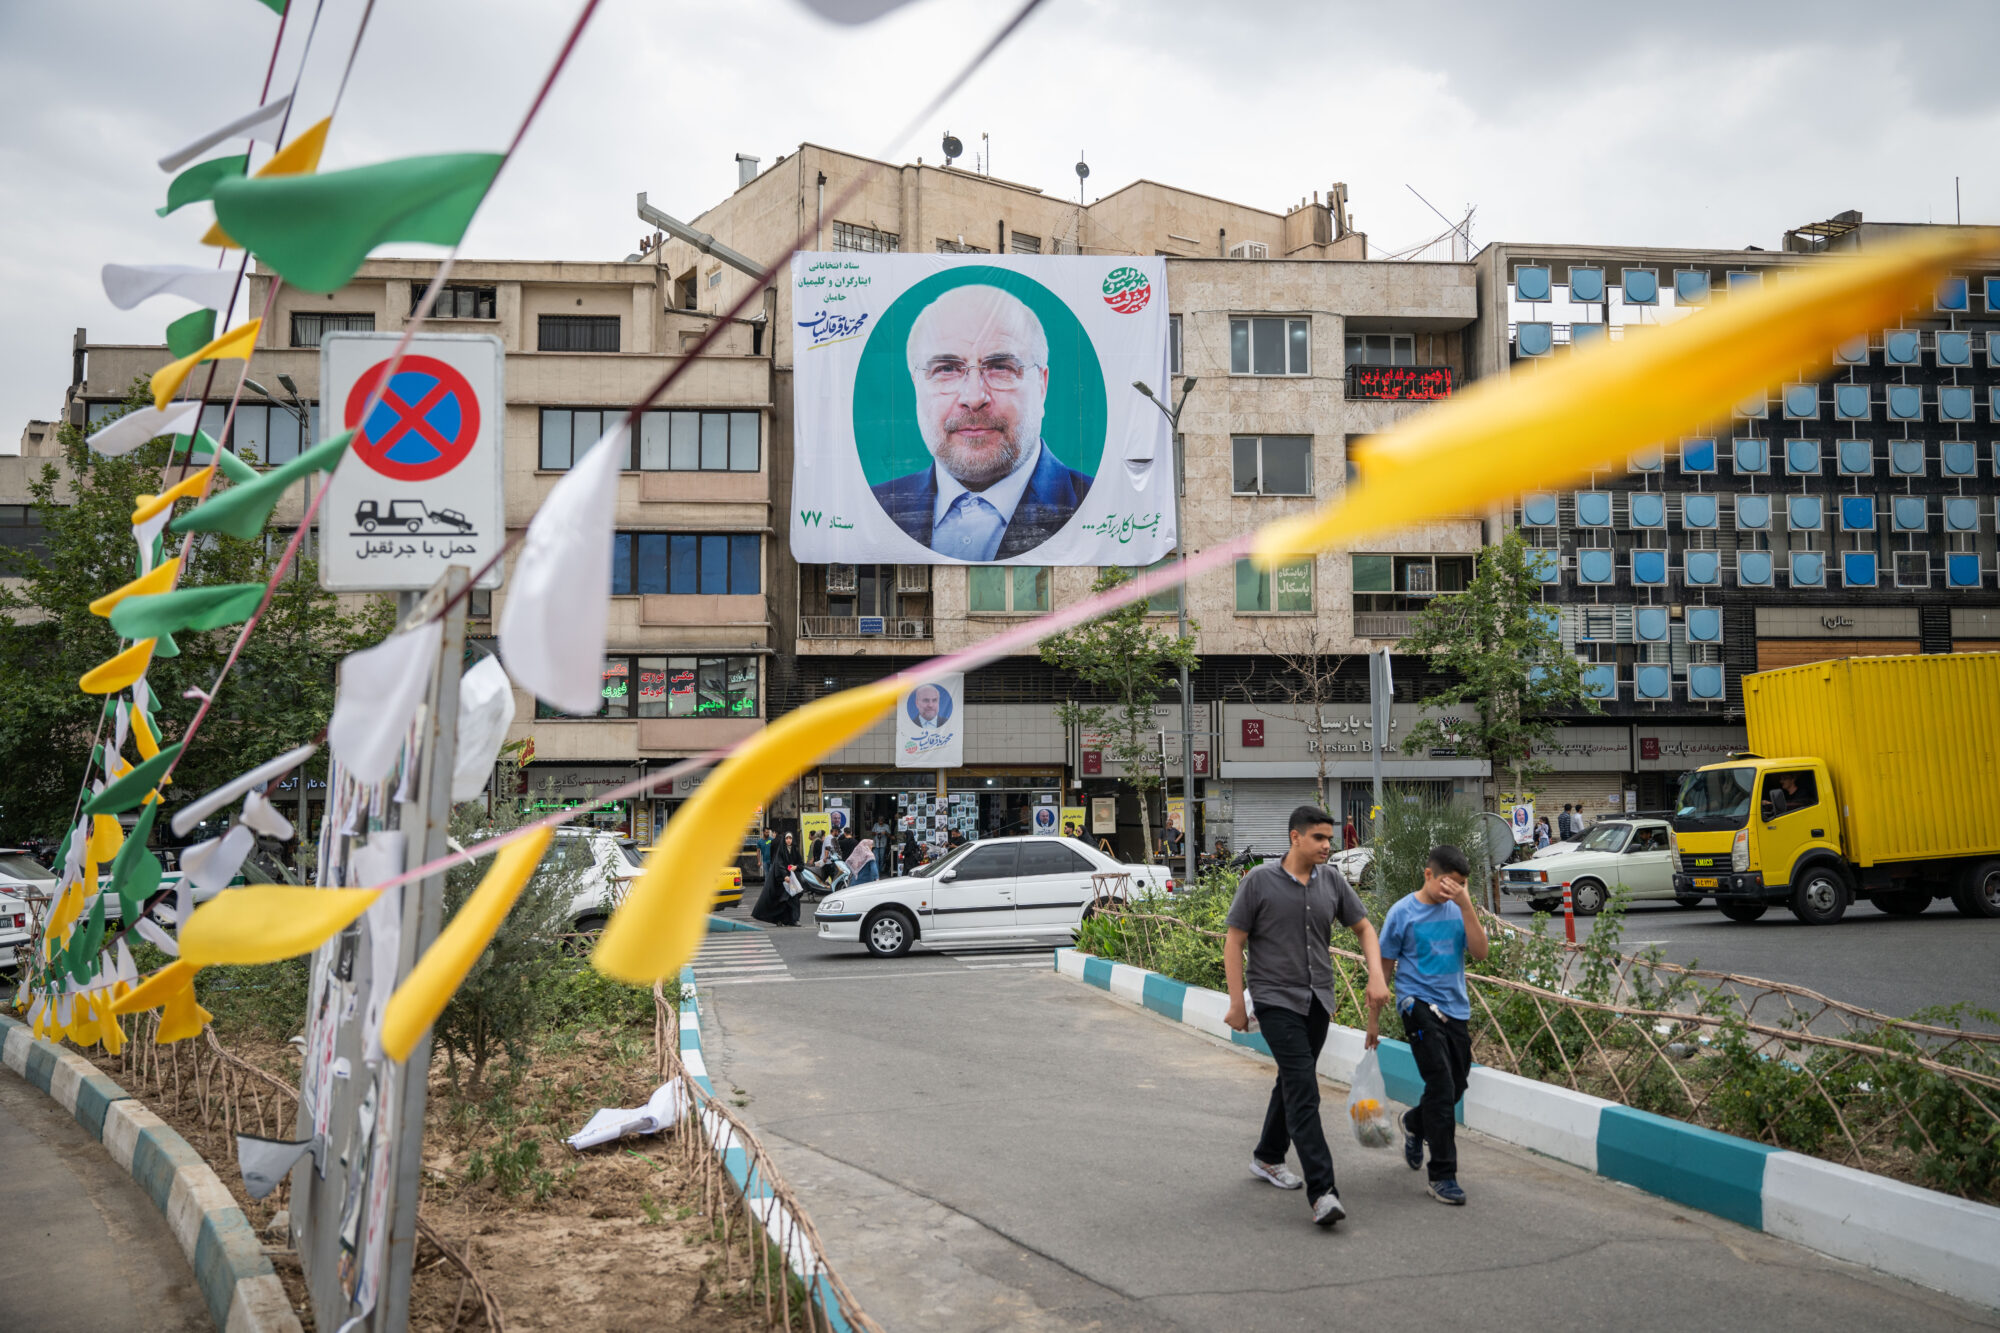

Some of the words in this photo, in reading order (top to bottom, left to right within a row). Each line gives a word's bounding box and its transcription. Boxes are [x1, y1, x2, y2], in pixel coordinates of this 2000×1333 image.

[808, 261, 842, 272] انتخاباتی
[844, 262, 859, 270] ستاد
[798, 276, 826, 288] کلیمیان
[828, 279, 833, 288] و
[823, 293, 847, 303] حامیان
[800, 510, 823, 528] ۷۷
[829, 516, 854, 529] ستاد
[356, 540, 416, 559] جرثقیل
[423, 540, 434, 558] با
[439, 540, 476, 559] حمل
[641, 671, 665, 684] فوری
[671, 671, 695, 683] عکس
[640, 686, 665, 698] کودک
[1308, 740, 1358, 753] Prsian
